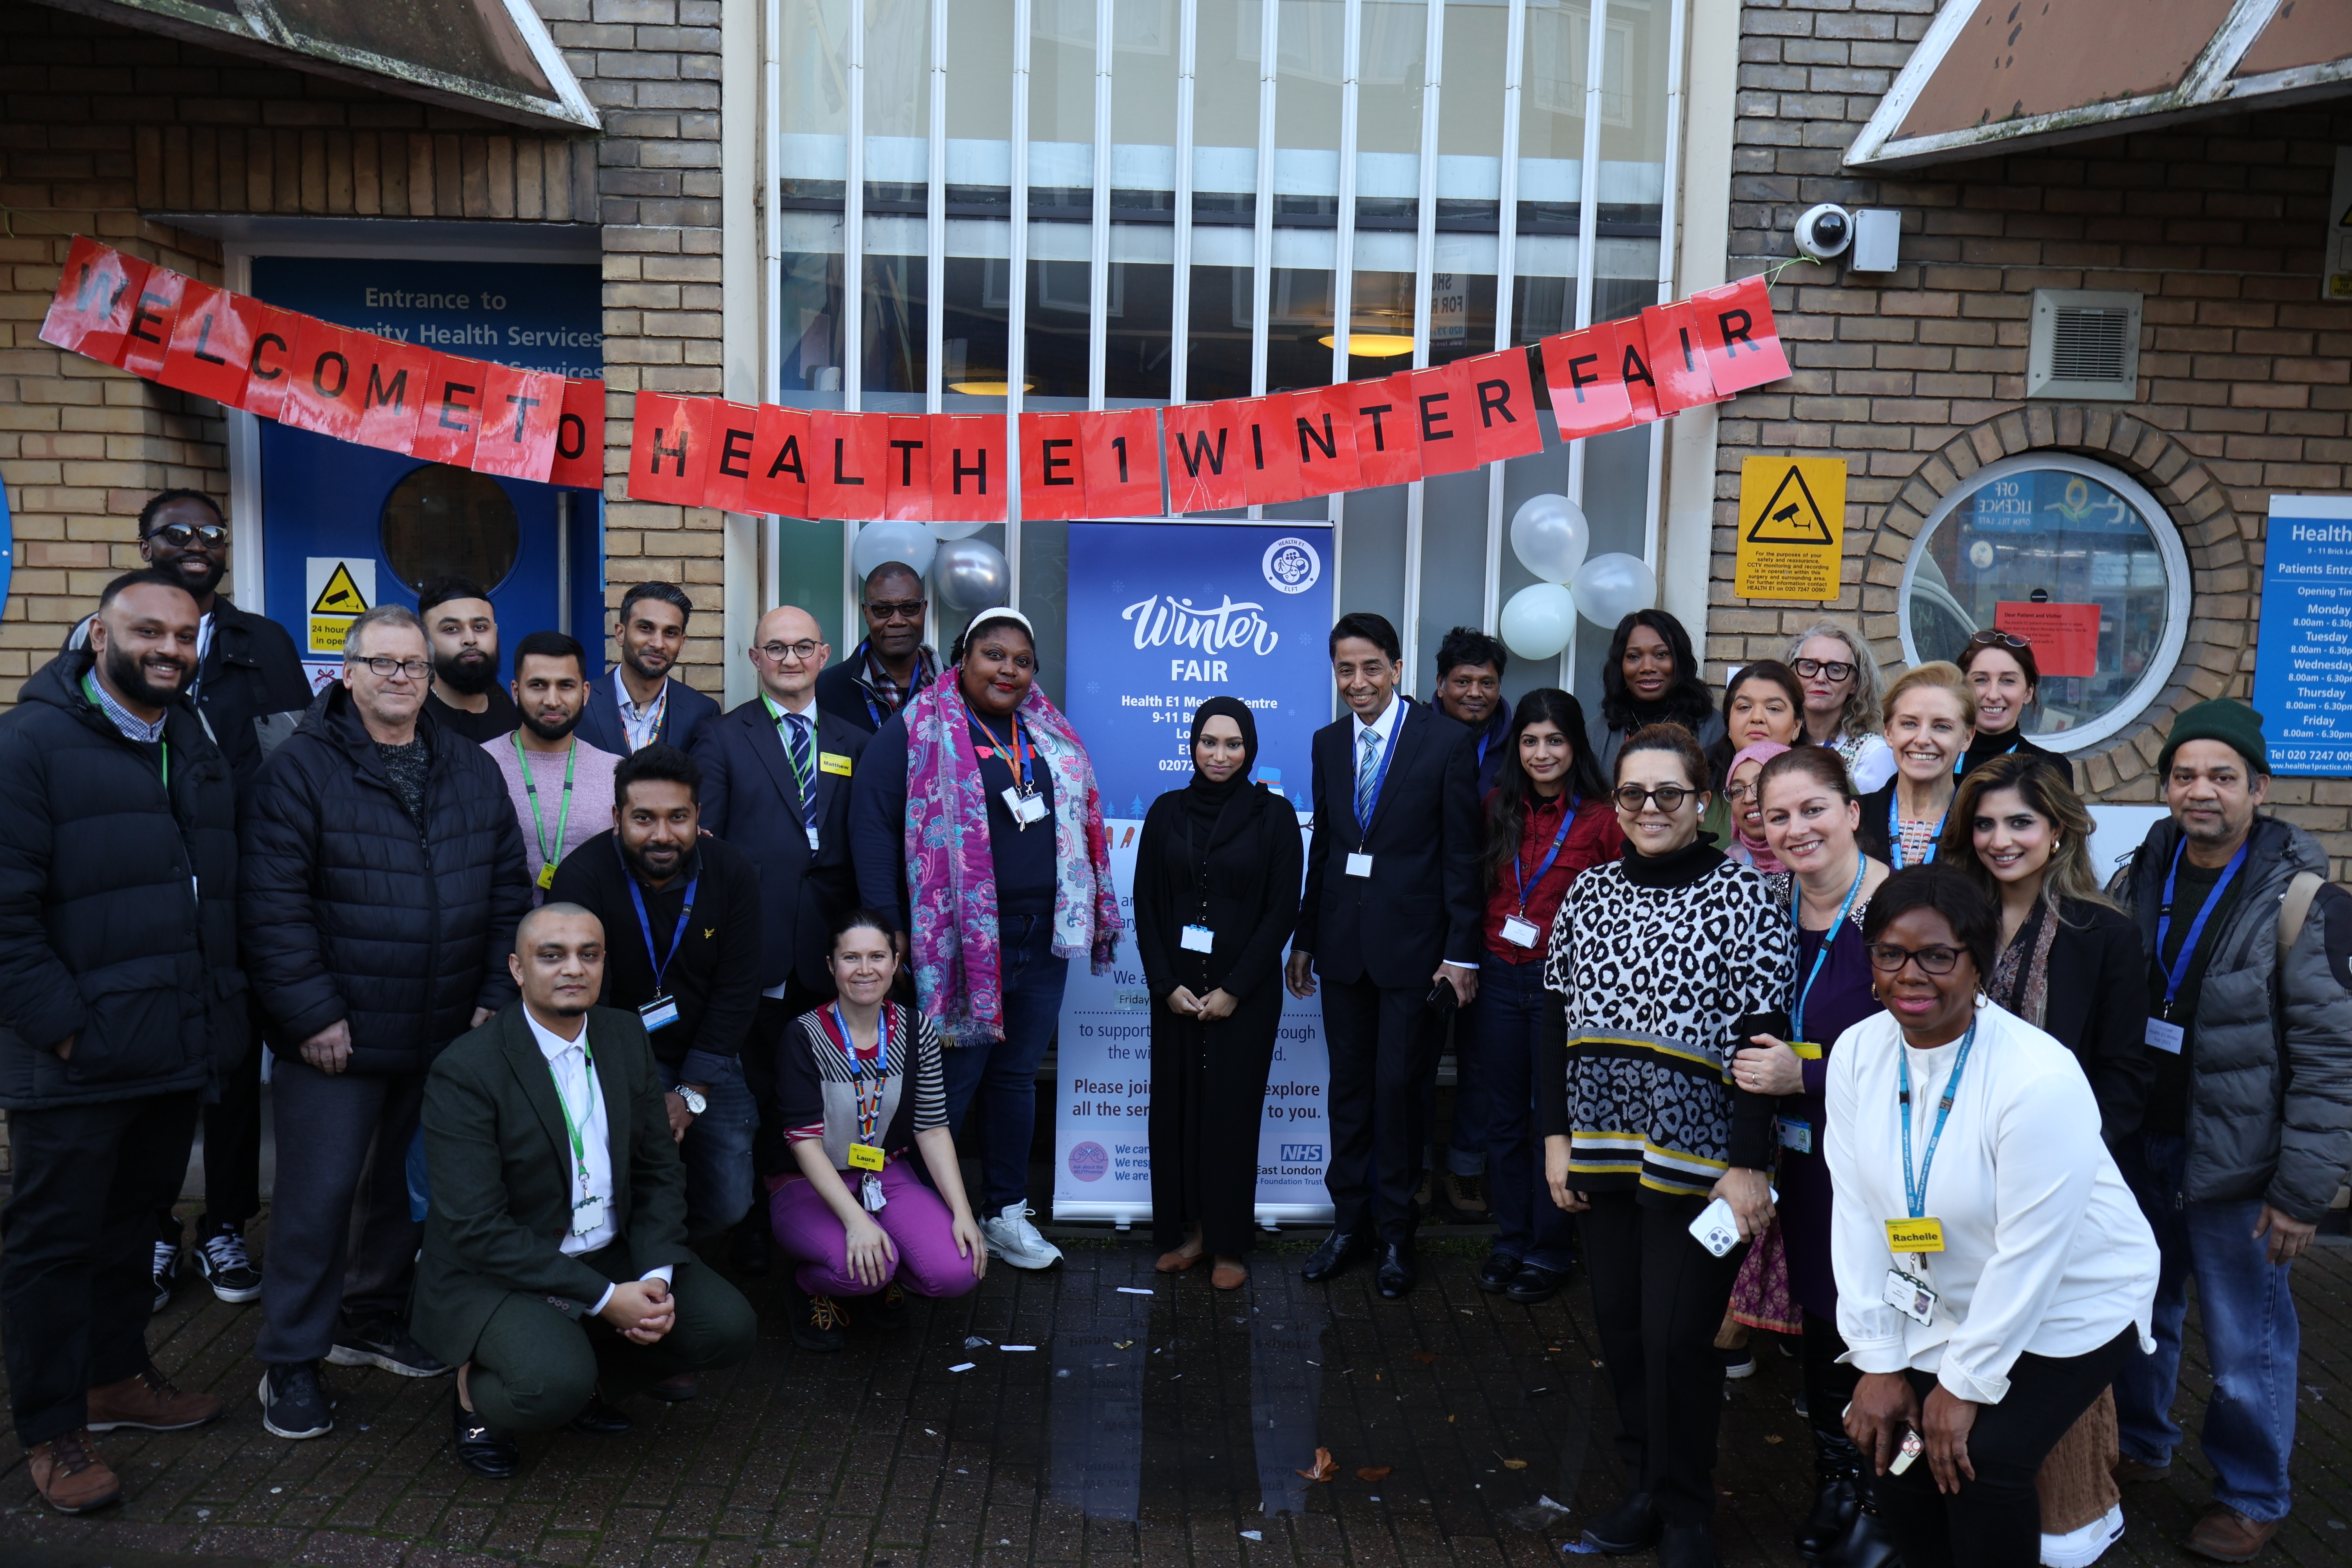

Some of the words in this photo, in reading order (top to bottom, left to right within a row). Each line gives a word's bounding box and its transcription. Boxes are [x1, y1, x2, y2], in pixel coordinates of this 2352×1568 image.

[366, 288, 470, 309] Entrance
[481, 292, 506, 310] to
[420, 324, 498, 345] Health
[508, 327, 603, 347] Services
[75, 263, 476, 432] WELCOME
[507, 394, 586, 459] TO
[651, 427, 986, 495] HEALTH
[1042, 436, 1128, 486] E1
[1176, 379, 1517, 477] WINTER
[1568, 308, 1761, 404] FAIR
[2292, 525, 2352, 542] Health
[2279, 563, 2323, 574] Patients
[2298, 586, 2336, 597] Opening
[2308, 604, 2350, 617] Monday
[1122, 594, 1278, 655] Winter
[2293, 618, 2323, 626] 8.00am
[2306, 631, 2348, 644] Tuesday
[1171, 659, 1229, 682] FAIR
[2294, 659, 2352, 672] Wednesday
[2298, 687, 2346, 700] Thursday
[1122, 695, 1162, 707] Health
[1166, 696, 1179, 707] E1
[2286, 701, 2316, 710] 8.00am
[1153, 711, 1178, 722] 9-11
[2303, 715, 2335, 728] Friday
[2283, 729, 2313, 737] 8.00am
[2322, 730, 2352, 740] 6.30pm
[2270, 750, 2284, 759] Tel
[2288, 750, 2306, 760] 020
[2310, 751, 2334, 760] 7247
[824, 761, 849, 769] Matthew
[1113, 971, 1136, 984] We
[1120, 995, 1150, 1004] Friday
[1080, 1024, 1093, 1037] to
[1098, 1025, 1151, 1040] support
[847, 1046, 856, 1060] NHS
[1108, 1046, 1130, 1059] the
[1074, 1079, 1123, 1094] Please
[1265, 1081, 1320, 1100] explore
[1073, 1102, 1091, 1116] all
[1096, 1102, 1121, 1116] the
[1267, 1105, 1283, 1118] to
[1289, 1107, 1321, 1122] you.
[1115, 1144, 1130, 1154] We
[1282, 1145, 1321, 1160] NHS
[857, 1154, 875, 1163] Laura
[1115, 1158, 1130, 1167] We
[1115, 1171, 1130, 1181] We
[1257, 1165, 1278, 1175] East
[1281, 1165, 1322, 1176] London
[1893, 1233, 1938, 1242] Rachelle
